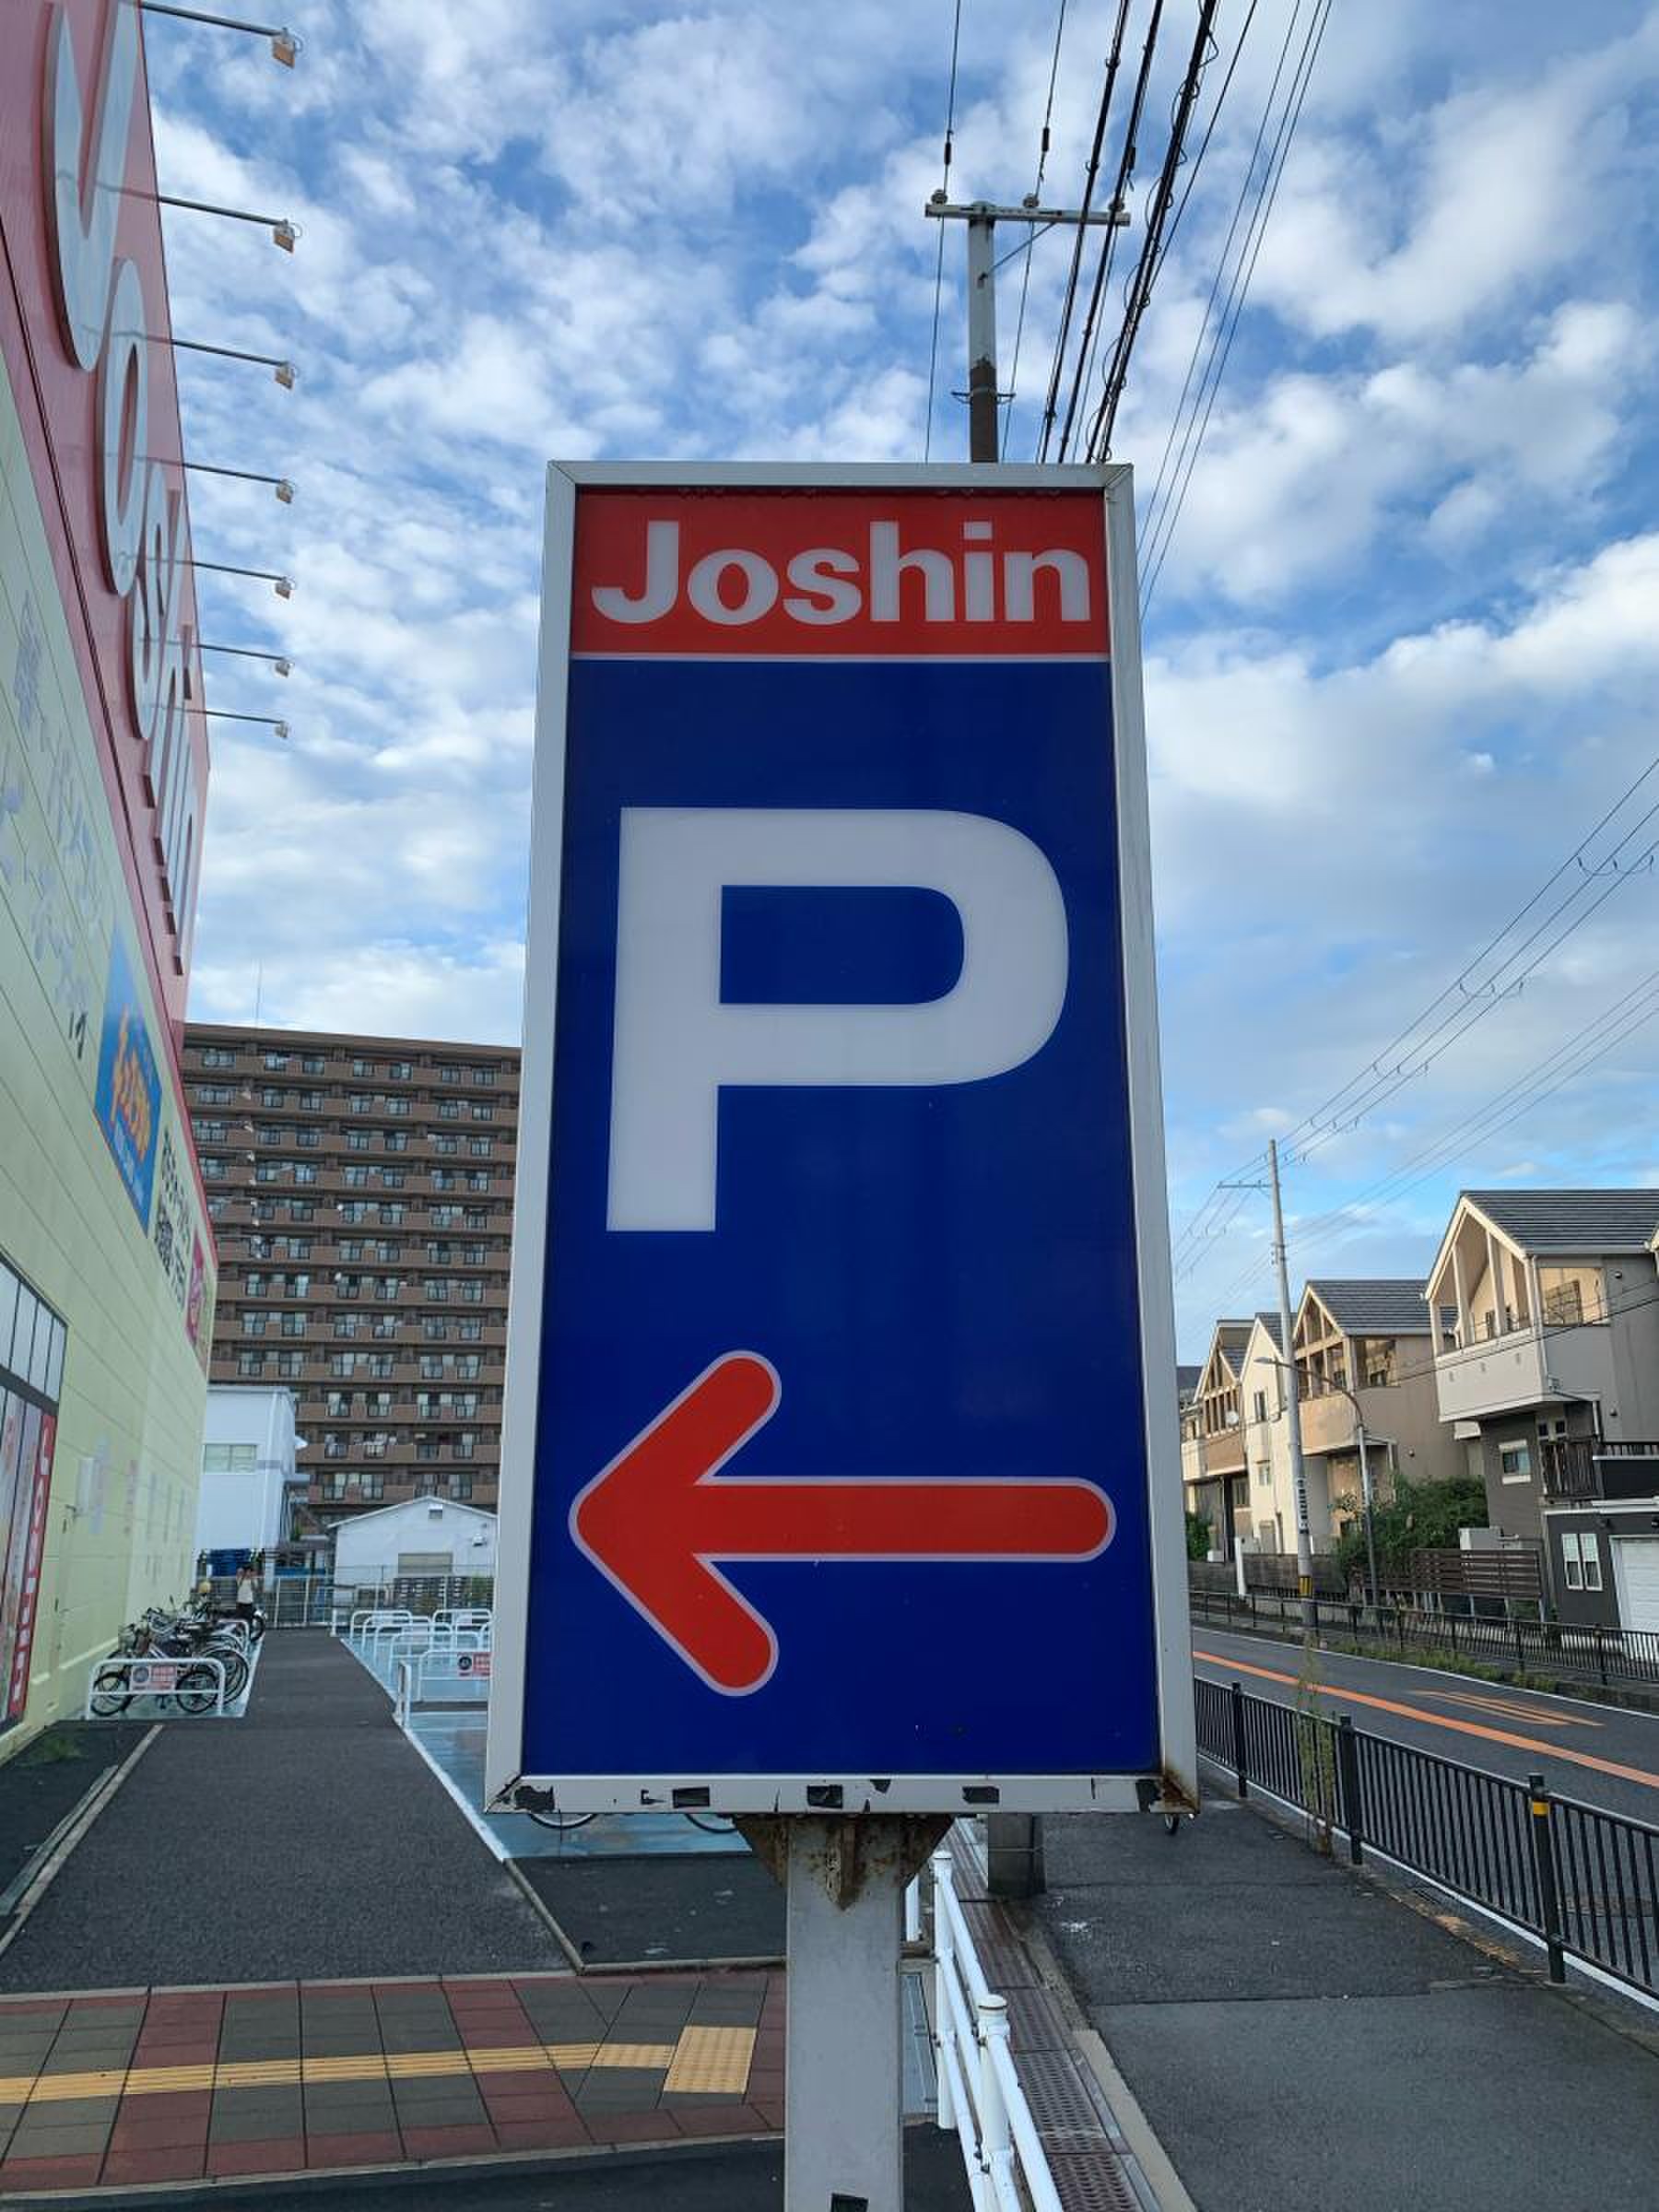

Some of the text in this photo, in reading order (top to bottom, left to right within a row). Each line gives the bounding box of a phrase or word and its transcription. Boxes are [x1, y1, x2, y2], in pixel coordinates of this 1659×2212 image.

[49, 0, 195, 973] Joshin
[591, 519, 1091, 626] Joshin
[606, 806, 1069, 1232] P
